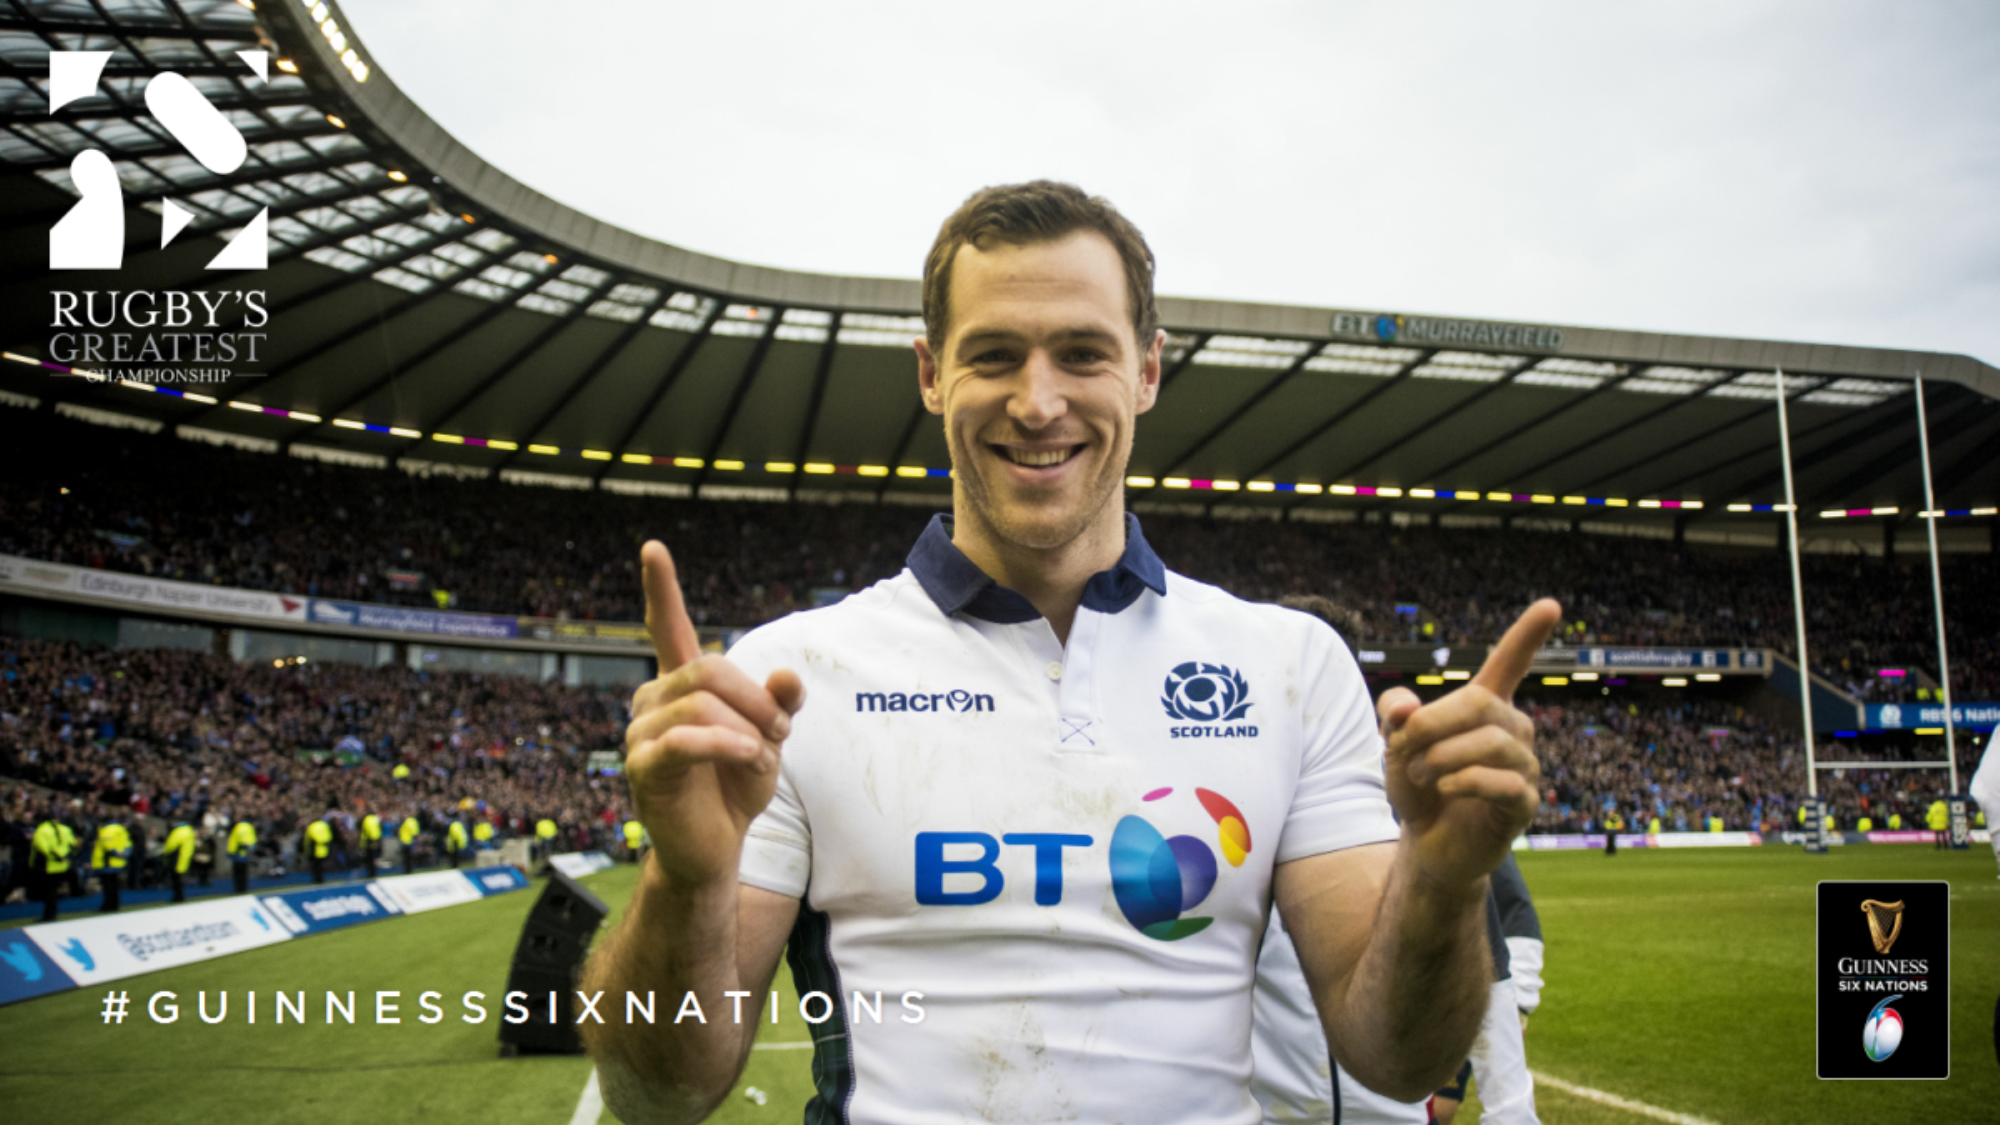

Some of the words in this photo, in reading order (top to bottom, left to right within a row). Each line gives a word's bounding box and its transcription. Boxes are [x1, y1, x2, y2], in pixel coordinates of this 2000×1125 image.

[1332, 312, 1370, 336] BT
[1405, 317, 1564, 348] MURRAYFIELD
[80, 572, 151, 600] Edinburgh
[155, 585, 202, 605] Napier
[206, 591, 274, 614] University
[856, 688, 996, 713] macron
[1169, 724, 1259, 739] SCOTLAND
[914, 831, 1094, 906] BT
